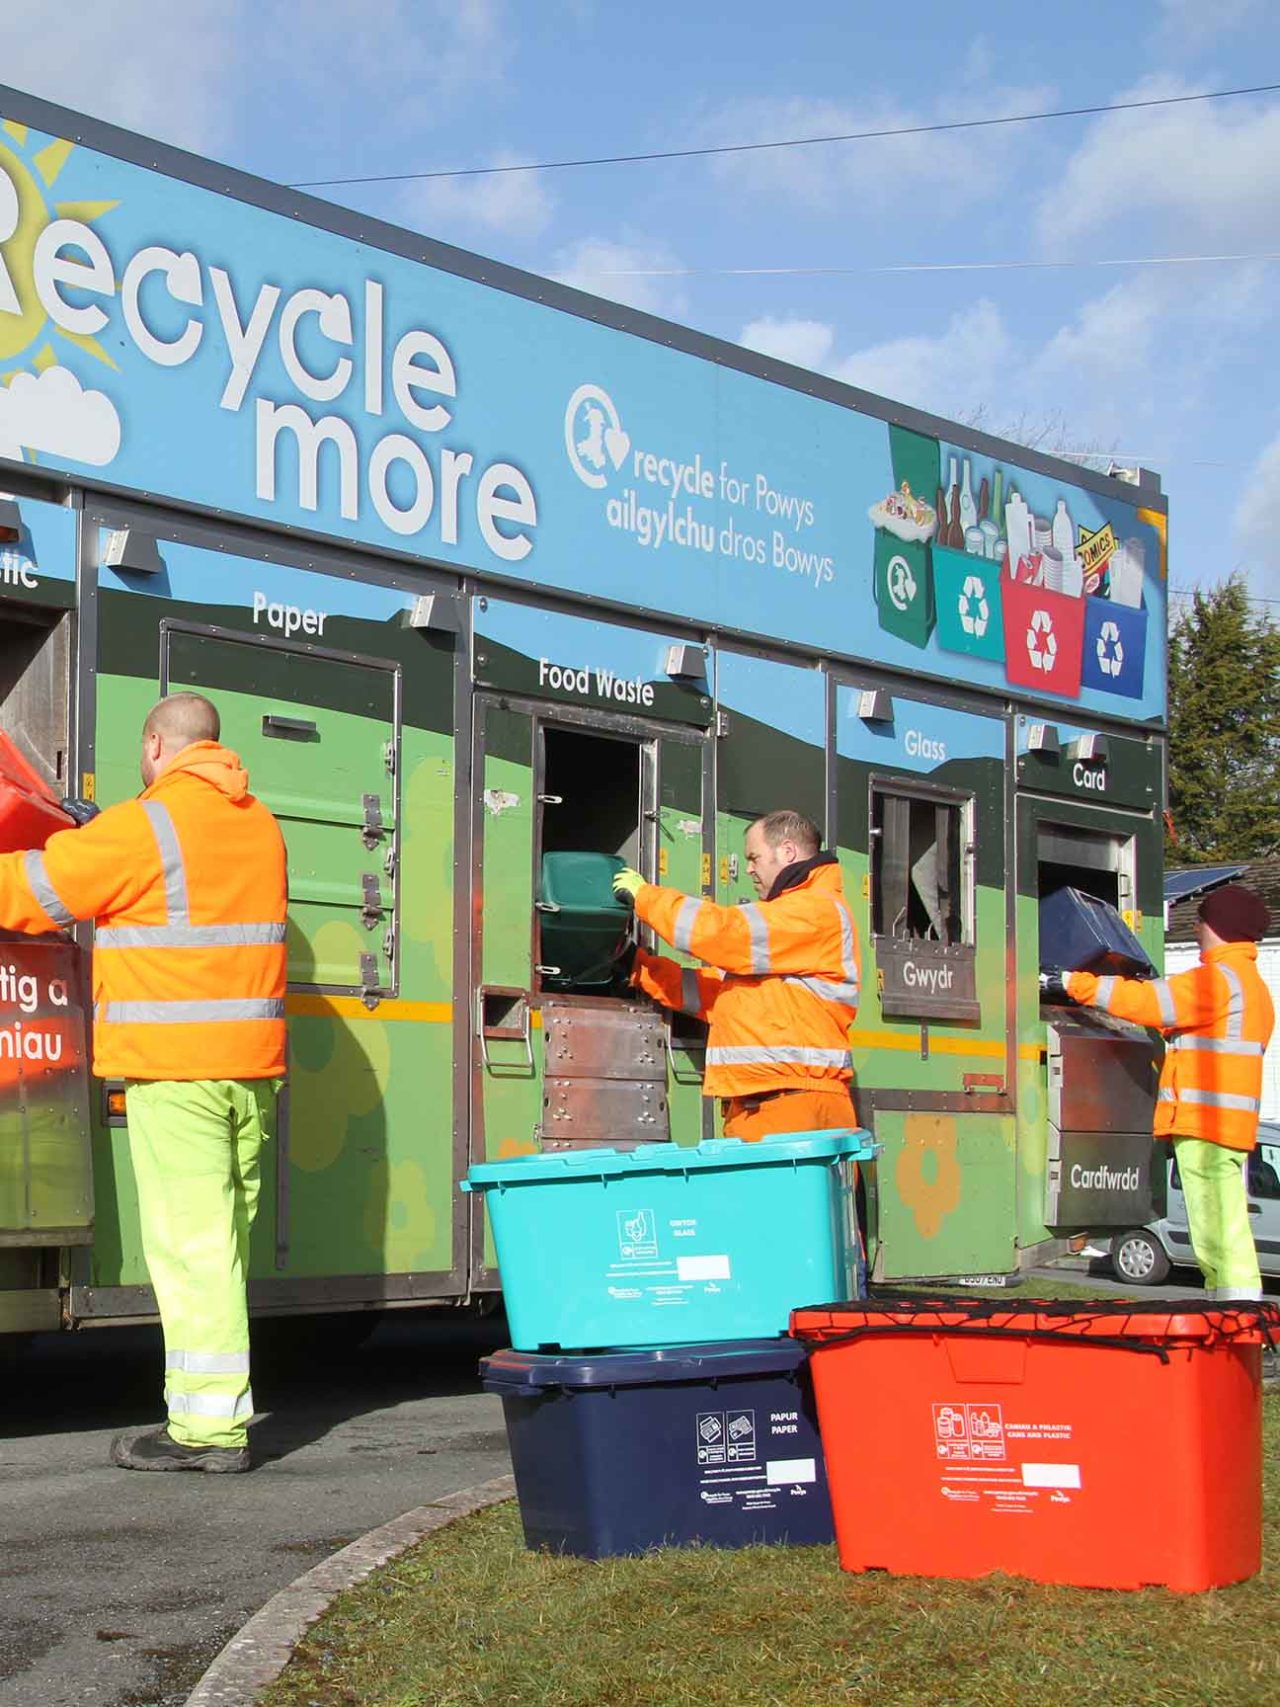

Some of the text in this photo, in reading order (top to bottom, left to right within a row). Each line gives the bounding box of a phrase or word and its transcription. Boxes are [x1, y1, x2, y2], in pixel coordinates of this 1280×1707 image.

[256, 398, 537, 562] more
[634, 449, 815, 532] recycle for Powys
[606, 489, 834, 588] ailgylchu dros Bowys
[253, 591, 328, 638] Paper
[539, 656, 655, 707] Food Waste
[904, 729, 946, 761] Glass
[1073, 763, 1106, 791] Card
[48, 979, 68, 1006] a
[903, 960, 953, 995] Gwydr
[1070, 1164, 1140, 1191] Cardfwrdd
[770, 1412, 798, 1421] PAPUR
[771, 1425, 798, 1434] PAPER
